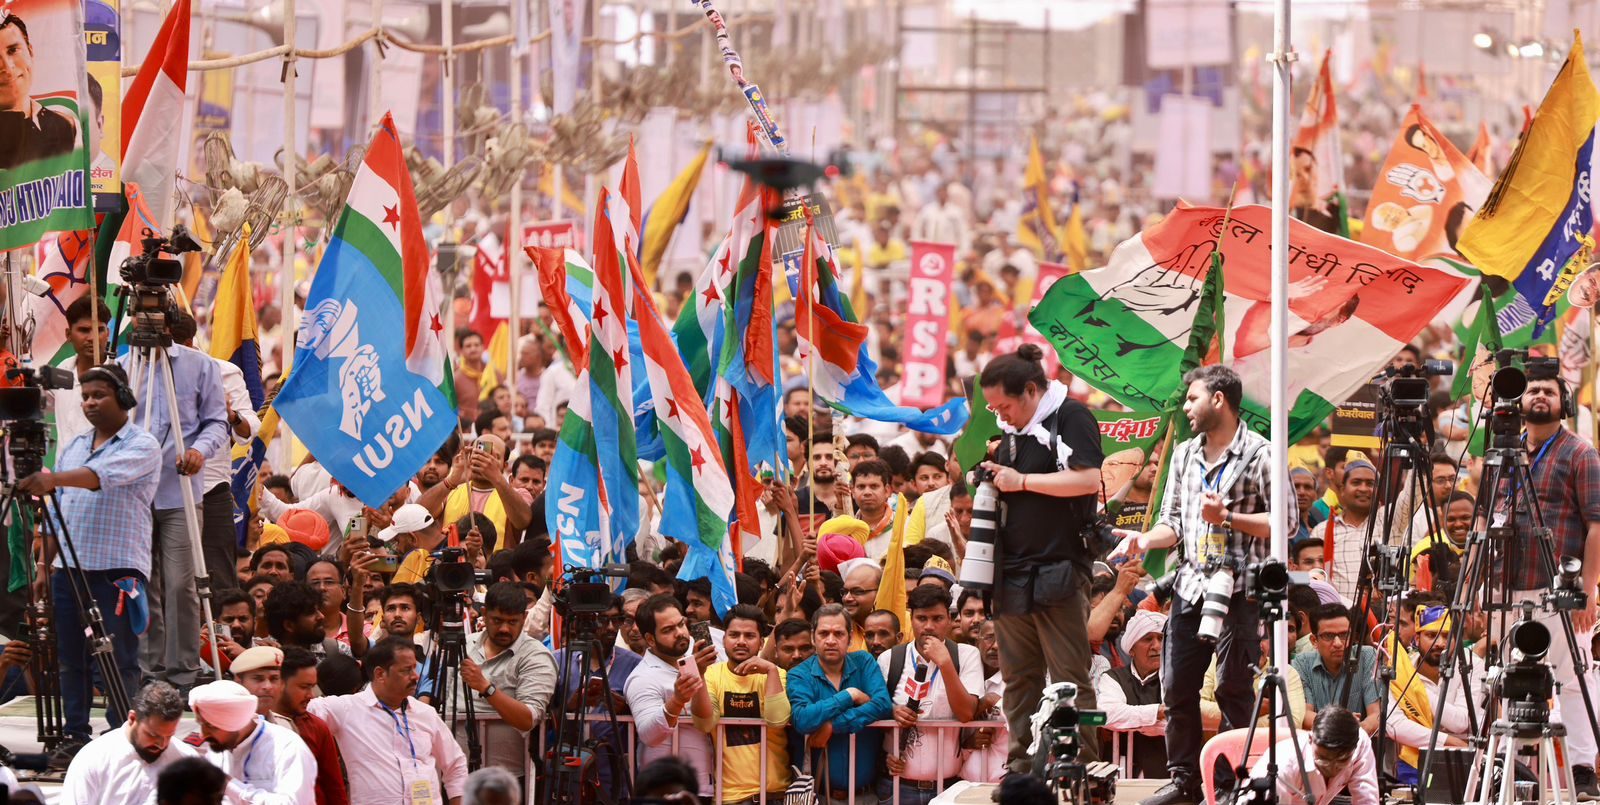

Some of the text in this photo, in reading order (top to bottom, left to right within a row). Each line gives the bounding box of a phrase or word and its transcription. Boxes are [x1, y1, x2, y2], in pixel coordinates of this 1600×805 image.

[1269, 245, 1342, 277] ांधी
[903, 278, 947, 399] RSP
[556, 482, 588, 569] NSU
